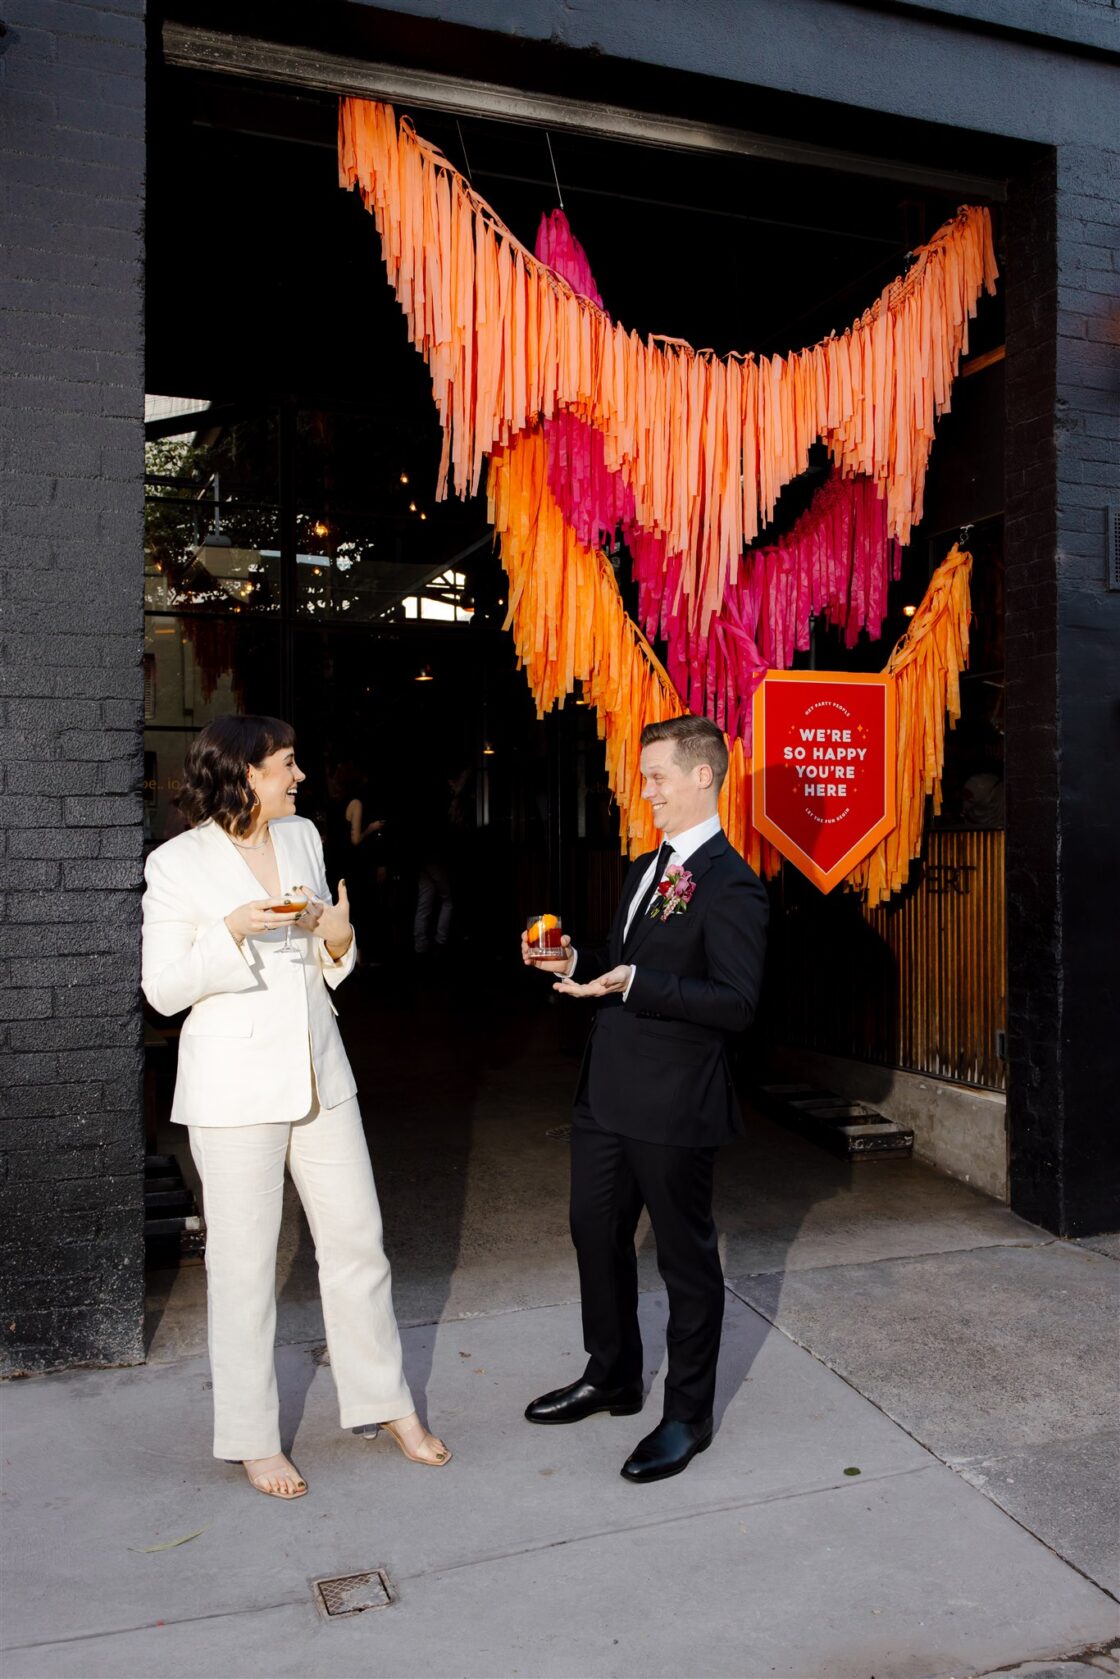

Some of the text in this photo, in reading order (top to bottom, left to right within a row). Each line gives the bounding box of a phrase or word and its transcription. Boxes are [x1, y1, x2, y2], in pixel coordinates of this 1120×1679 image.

[804, 705, 814, 716] HEY
[832, 702, 850, 717] PEOPLE
[799, 728, 852, 742] WE'RE
[783, 746, 867, 761] SO HAPPY
[795, 765, 855, 779] YOU'RE
[804, 783, 847, 797] HERE
[805, 807, 814, 817] LET
[836, 807, 850, 821] BEGIN
